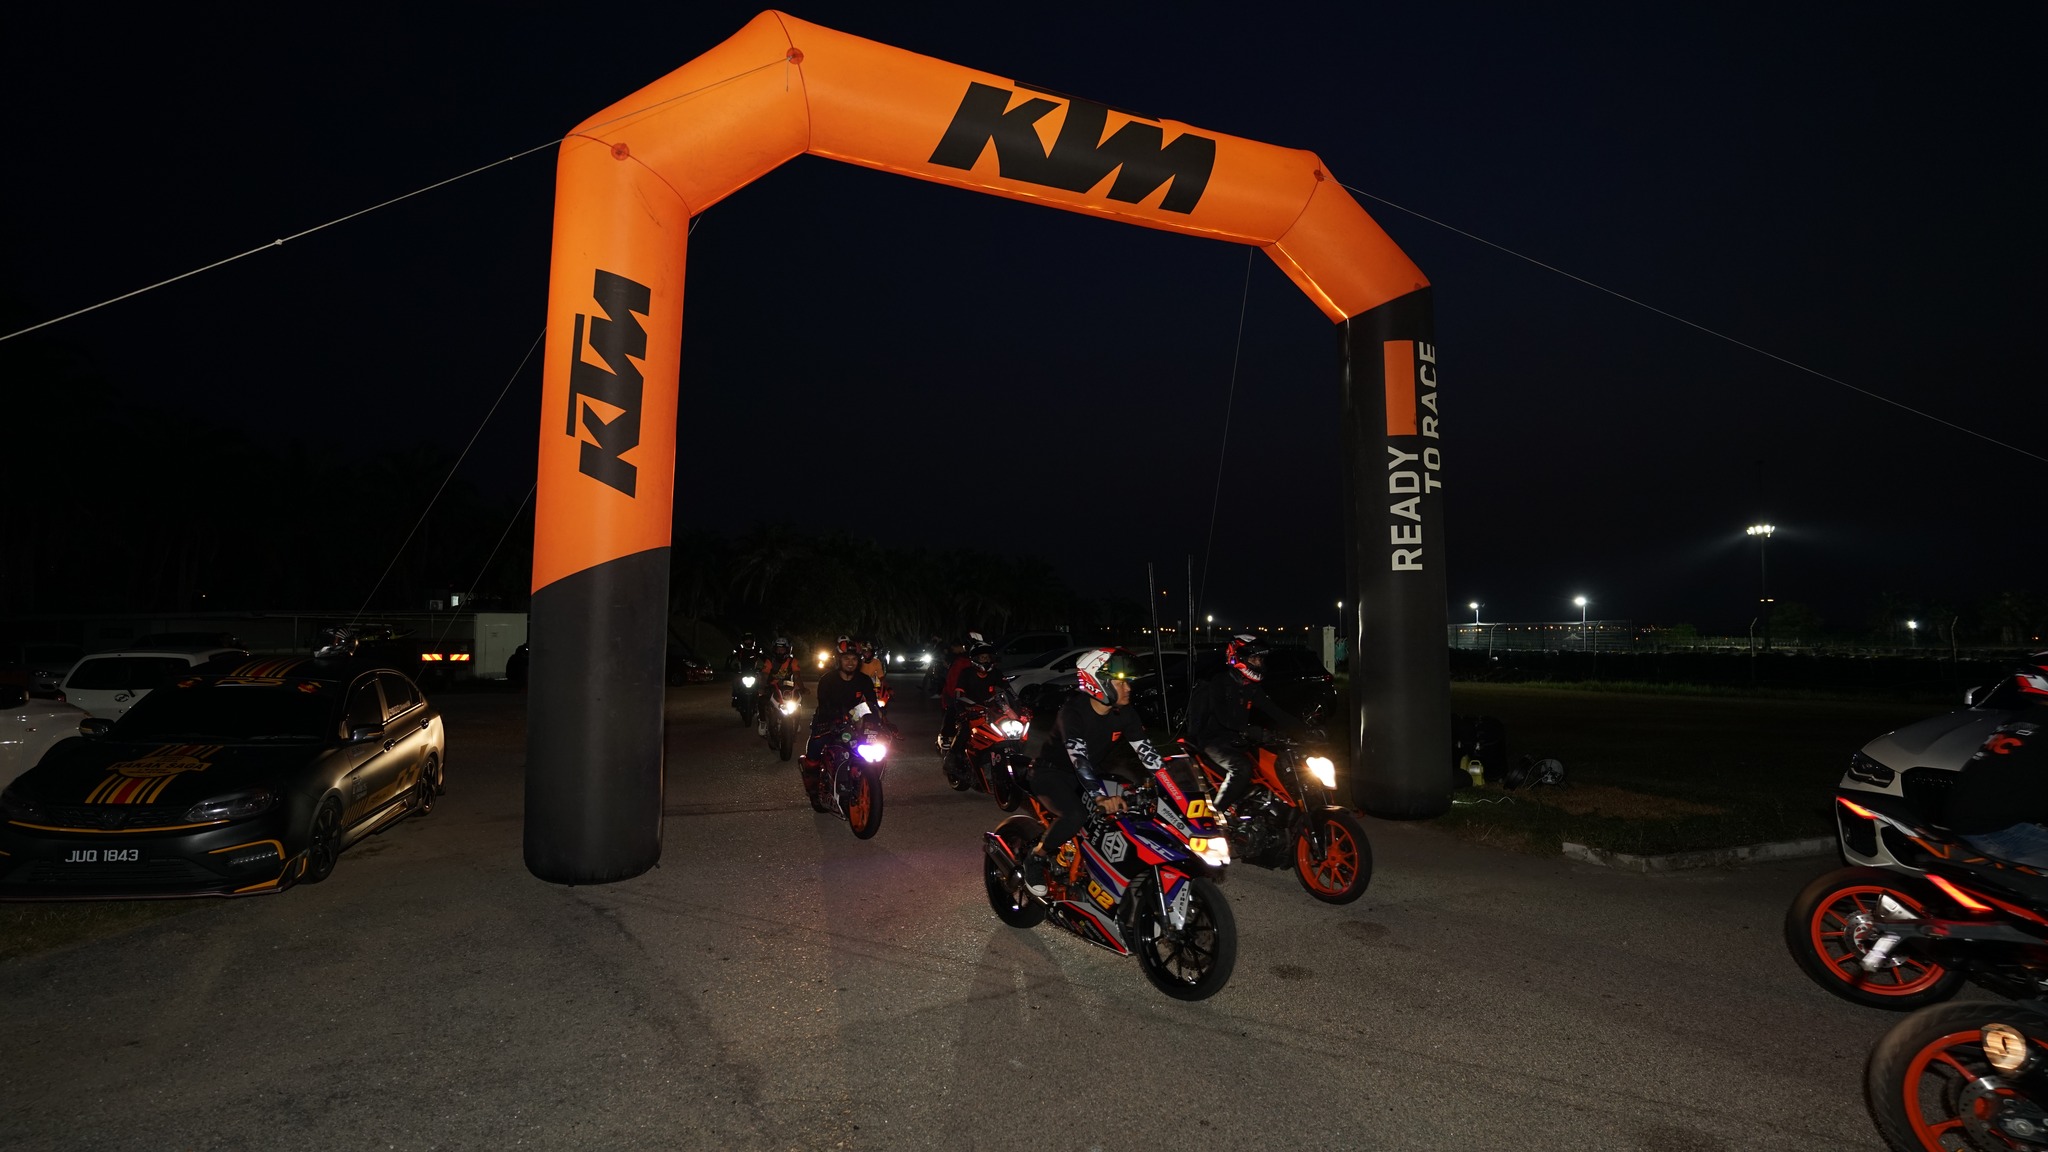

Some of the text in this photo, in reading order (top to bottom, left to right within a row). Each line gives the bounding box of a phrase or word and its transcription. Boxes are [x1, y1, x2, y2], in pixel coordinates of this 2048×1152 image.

[928, 80, 1217, 215] KTM
[566, 268, 652, 499] KTM
[1418, 341, 1442, 494] TO RACE
[1387, 445, 1423, 571] READY
[1084, 682, 1102, 694] KYT
[166, 762, 205, 770] SAGA
[65, 849, 139, 863] JUQ 1843
[1087, 879, 1116, 910] 02
